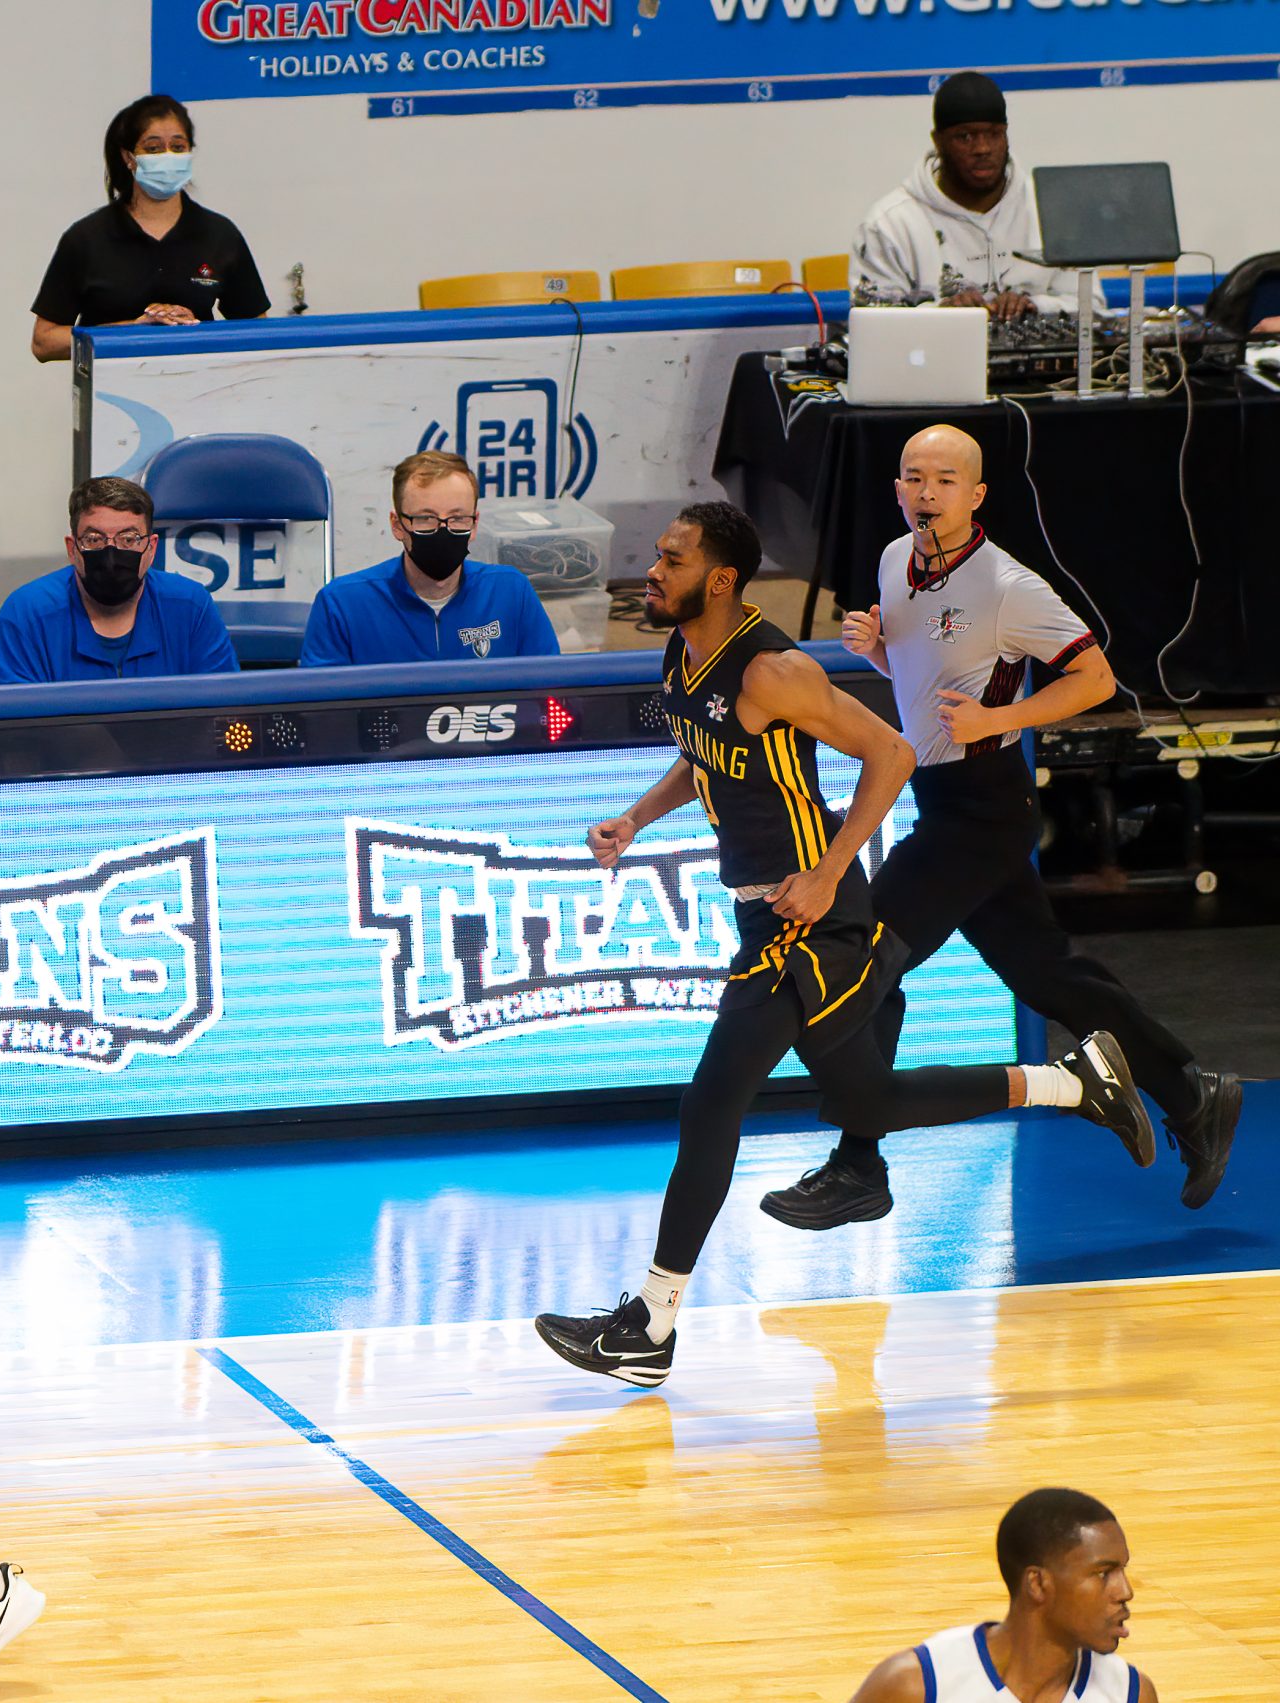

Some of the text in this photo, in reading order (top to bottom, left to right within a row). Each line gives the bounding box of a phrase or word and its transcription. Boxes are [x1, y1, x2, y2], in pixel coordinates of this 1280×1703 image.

[197, 0, 612, 43] GREAT CANADIAN
[260, 45, 546, 78] HOLIDAYS & COACHES
[392, 98, 415, 116] 61
[574, 90, 599, 108] 62
[748, 81, 774, 101] 63
[478, 418, 536, 457] 24
[478, 460, 537, 498] HR
[426, 704, 517, 744] OES
[449, 980, 624, 1036] KITCHENER
